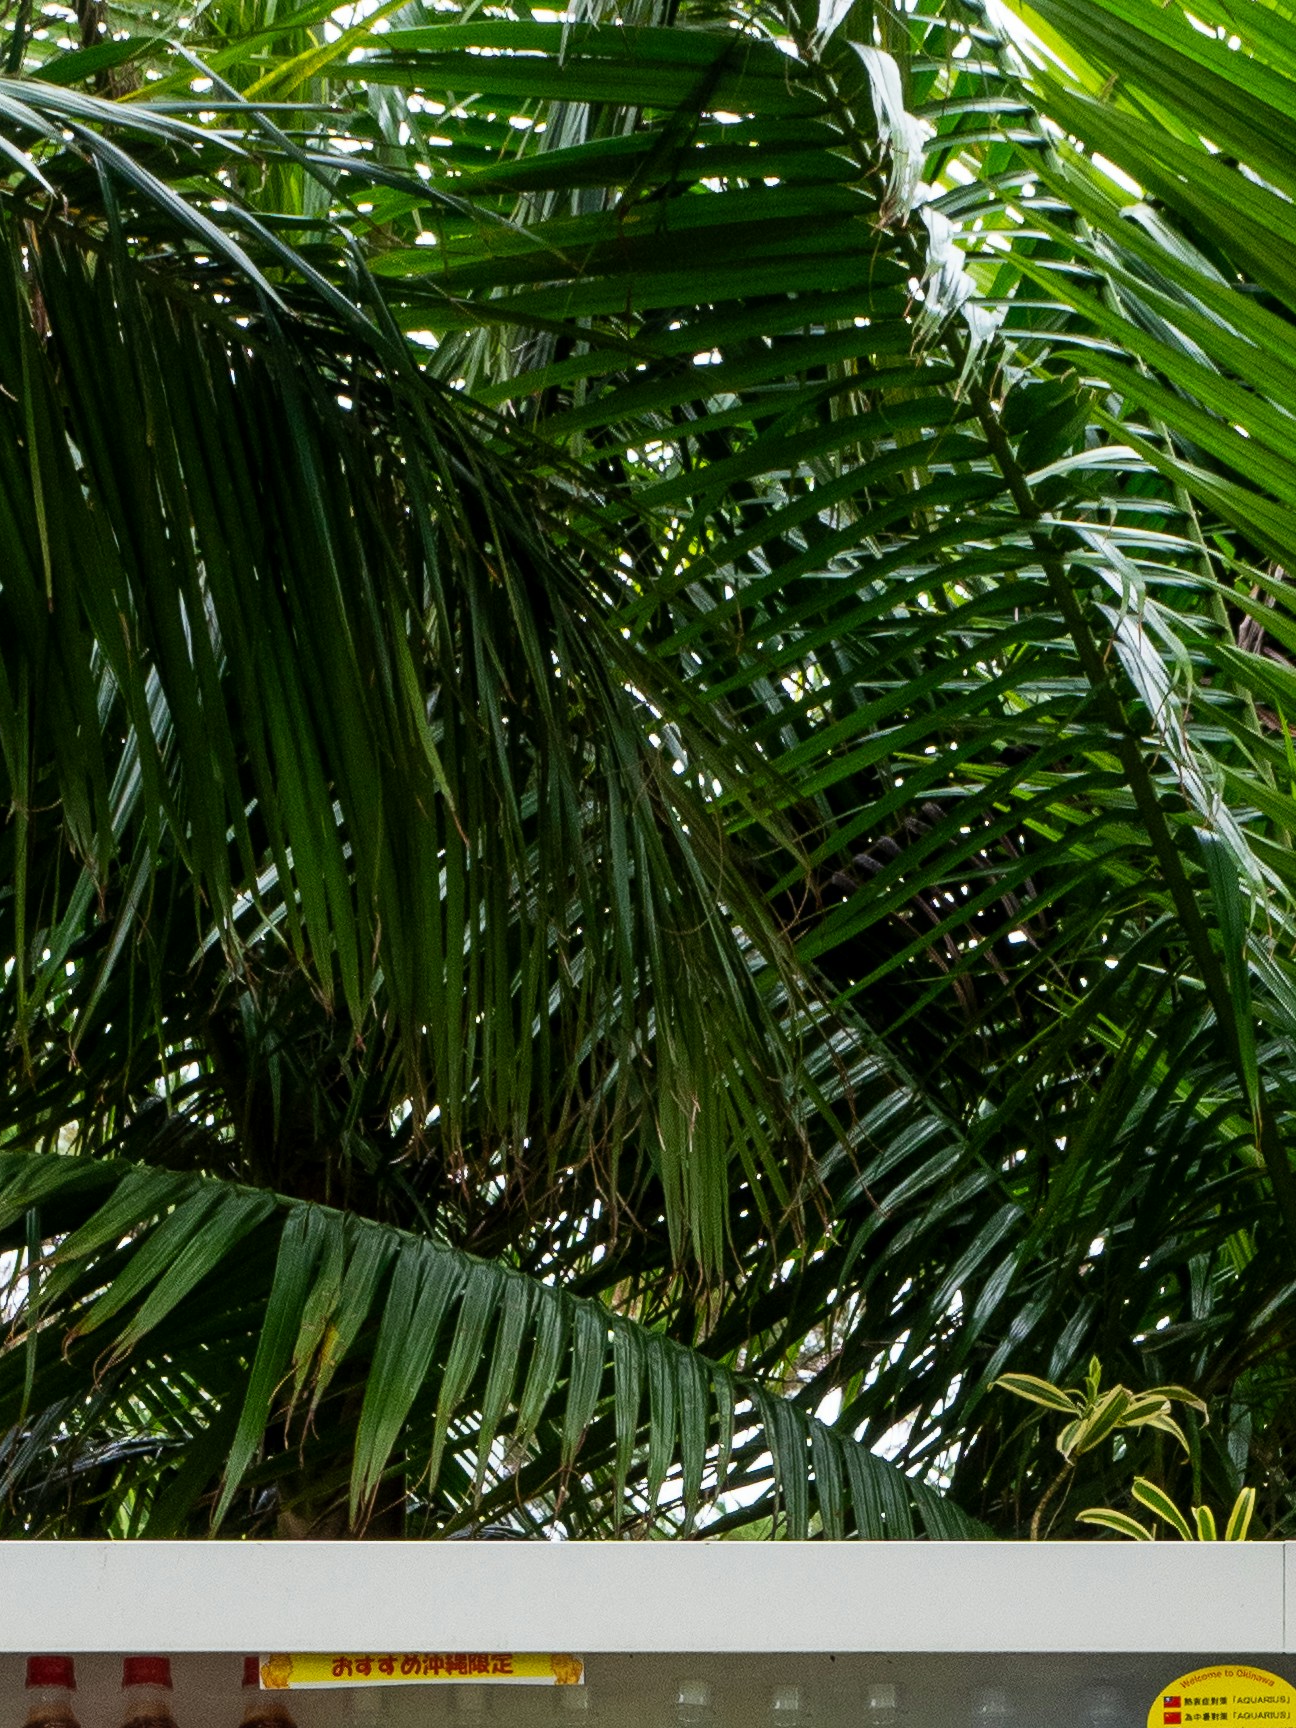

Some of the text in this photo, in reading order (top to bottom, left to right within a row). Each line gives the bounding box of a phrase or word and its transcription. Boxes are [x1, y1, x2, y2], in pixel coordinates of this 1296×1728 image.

[332, 1654, 514, 1676] おすすめ沖縄限定
[1180, 1670, 1222, 1688] Welcome
[1237, 1670, 1275, 1686] Okinawa
